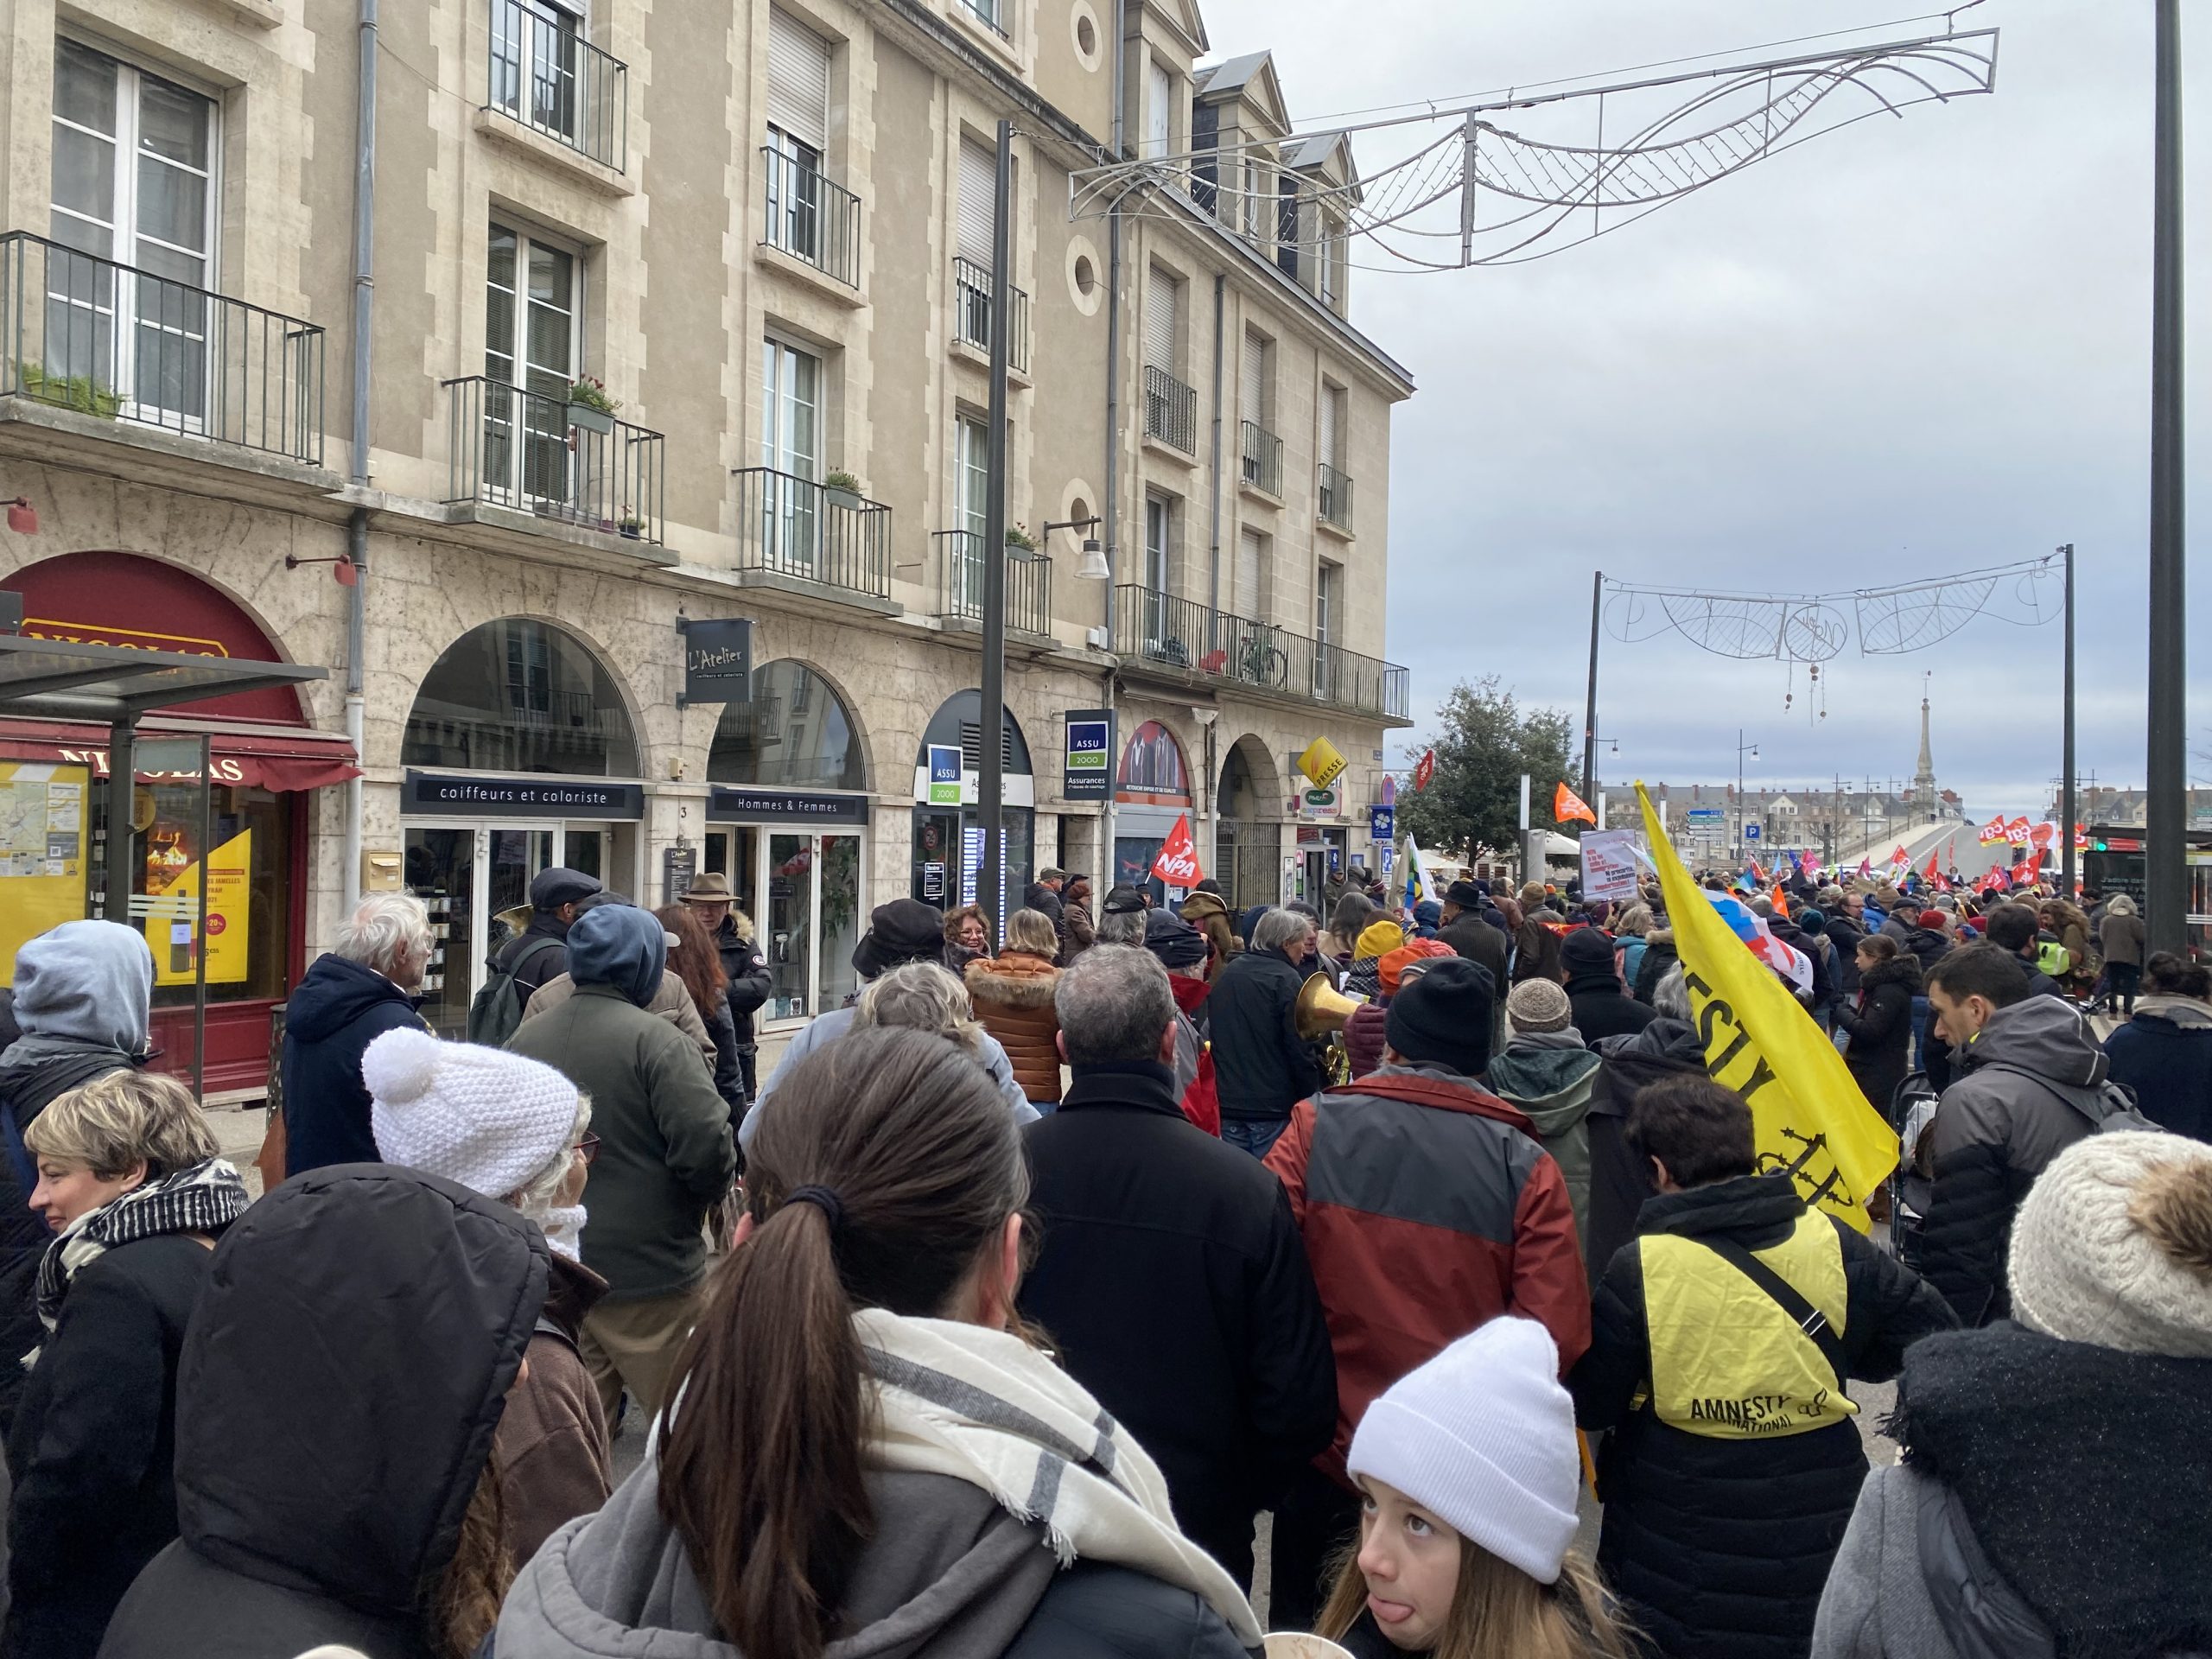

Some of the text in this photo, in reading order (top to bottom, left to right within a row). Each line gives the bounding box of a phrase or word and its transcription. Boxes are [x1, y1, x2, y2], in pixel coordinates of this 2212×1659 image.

[689, 647, 742, 671] L'Atelier
[1076, 740, 1099, 748] ASSU
[937, 768, 956, 779] ASSU
[1316, 758, 1343, 785] PRESSE
[440, 785, 607, 804] coiffeurs et coloriste
[937, 789, 955, 798] 2000
[681, 806, 687, 818] 3
[738, 798, 836, 812] Hommes & Femmes
[1749, 827, 1757, 836] P
[1157, 853, 1196, 877] NPA
[1691, 1395, 1792, 1422] AMNESTY
